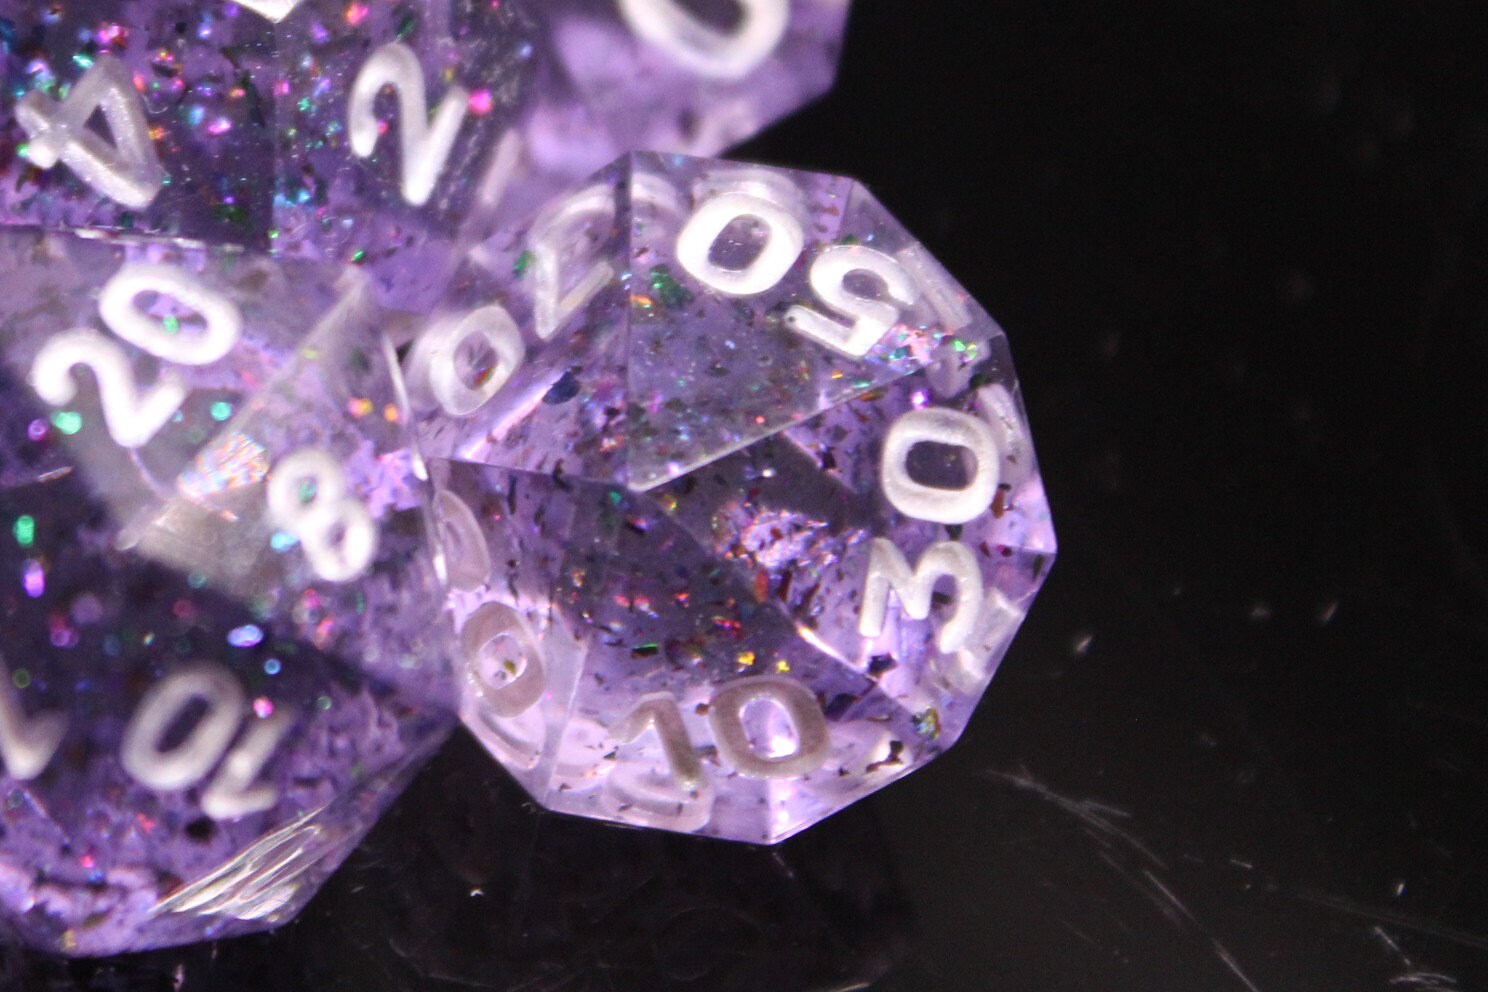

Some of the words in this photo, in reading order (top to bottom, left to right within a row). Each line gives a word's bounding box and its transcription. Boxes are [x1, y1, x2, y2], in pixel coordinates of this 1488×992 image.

[14, 52, 162, 209] 4
[349, 43, 469, 207] 2
[676, 188, 914, 360] 50
[32, 265, 246, 448] 20
[267, 448, 378, 584] 8
[858, 408, 1000, 655] 30
[120, 664, 300, 821] 10
[612, 676, 832, 793] 10
